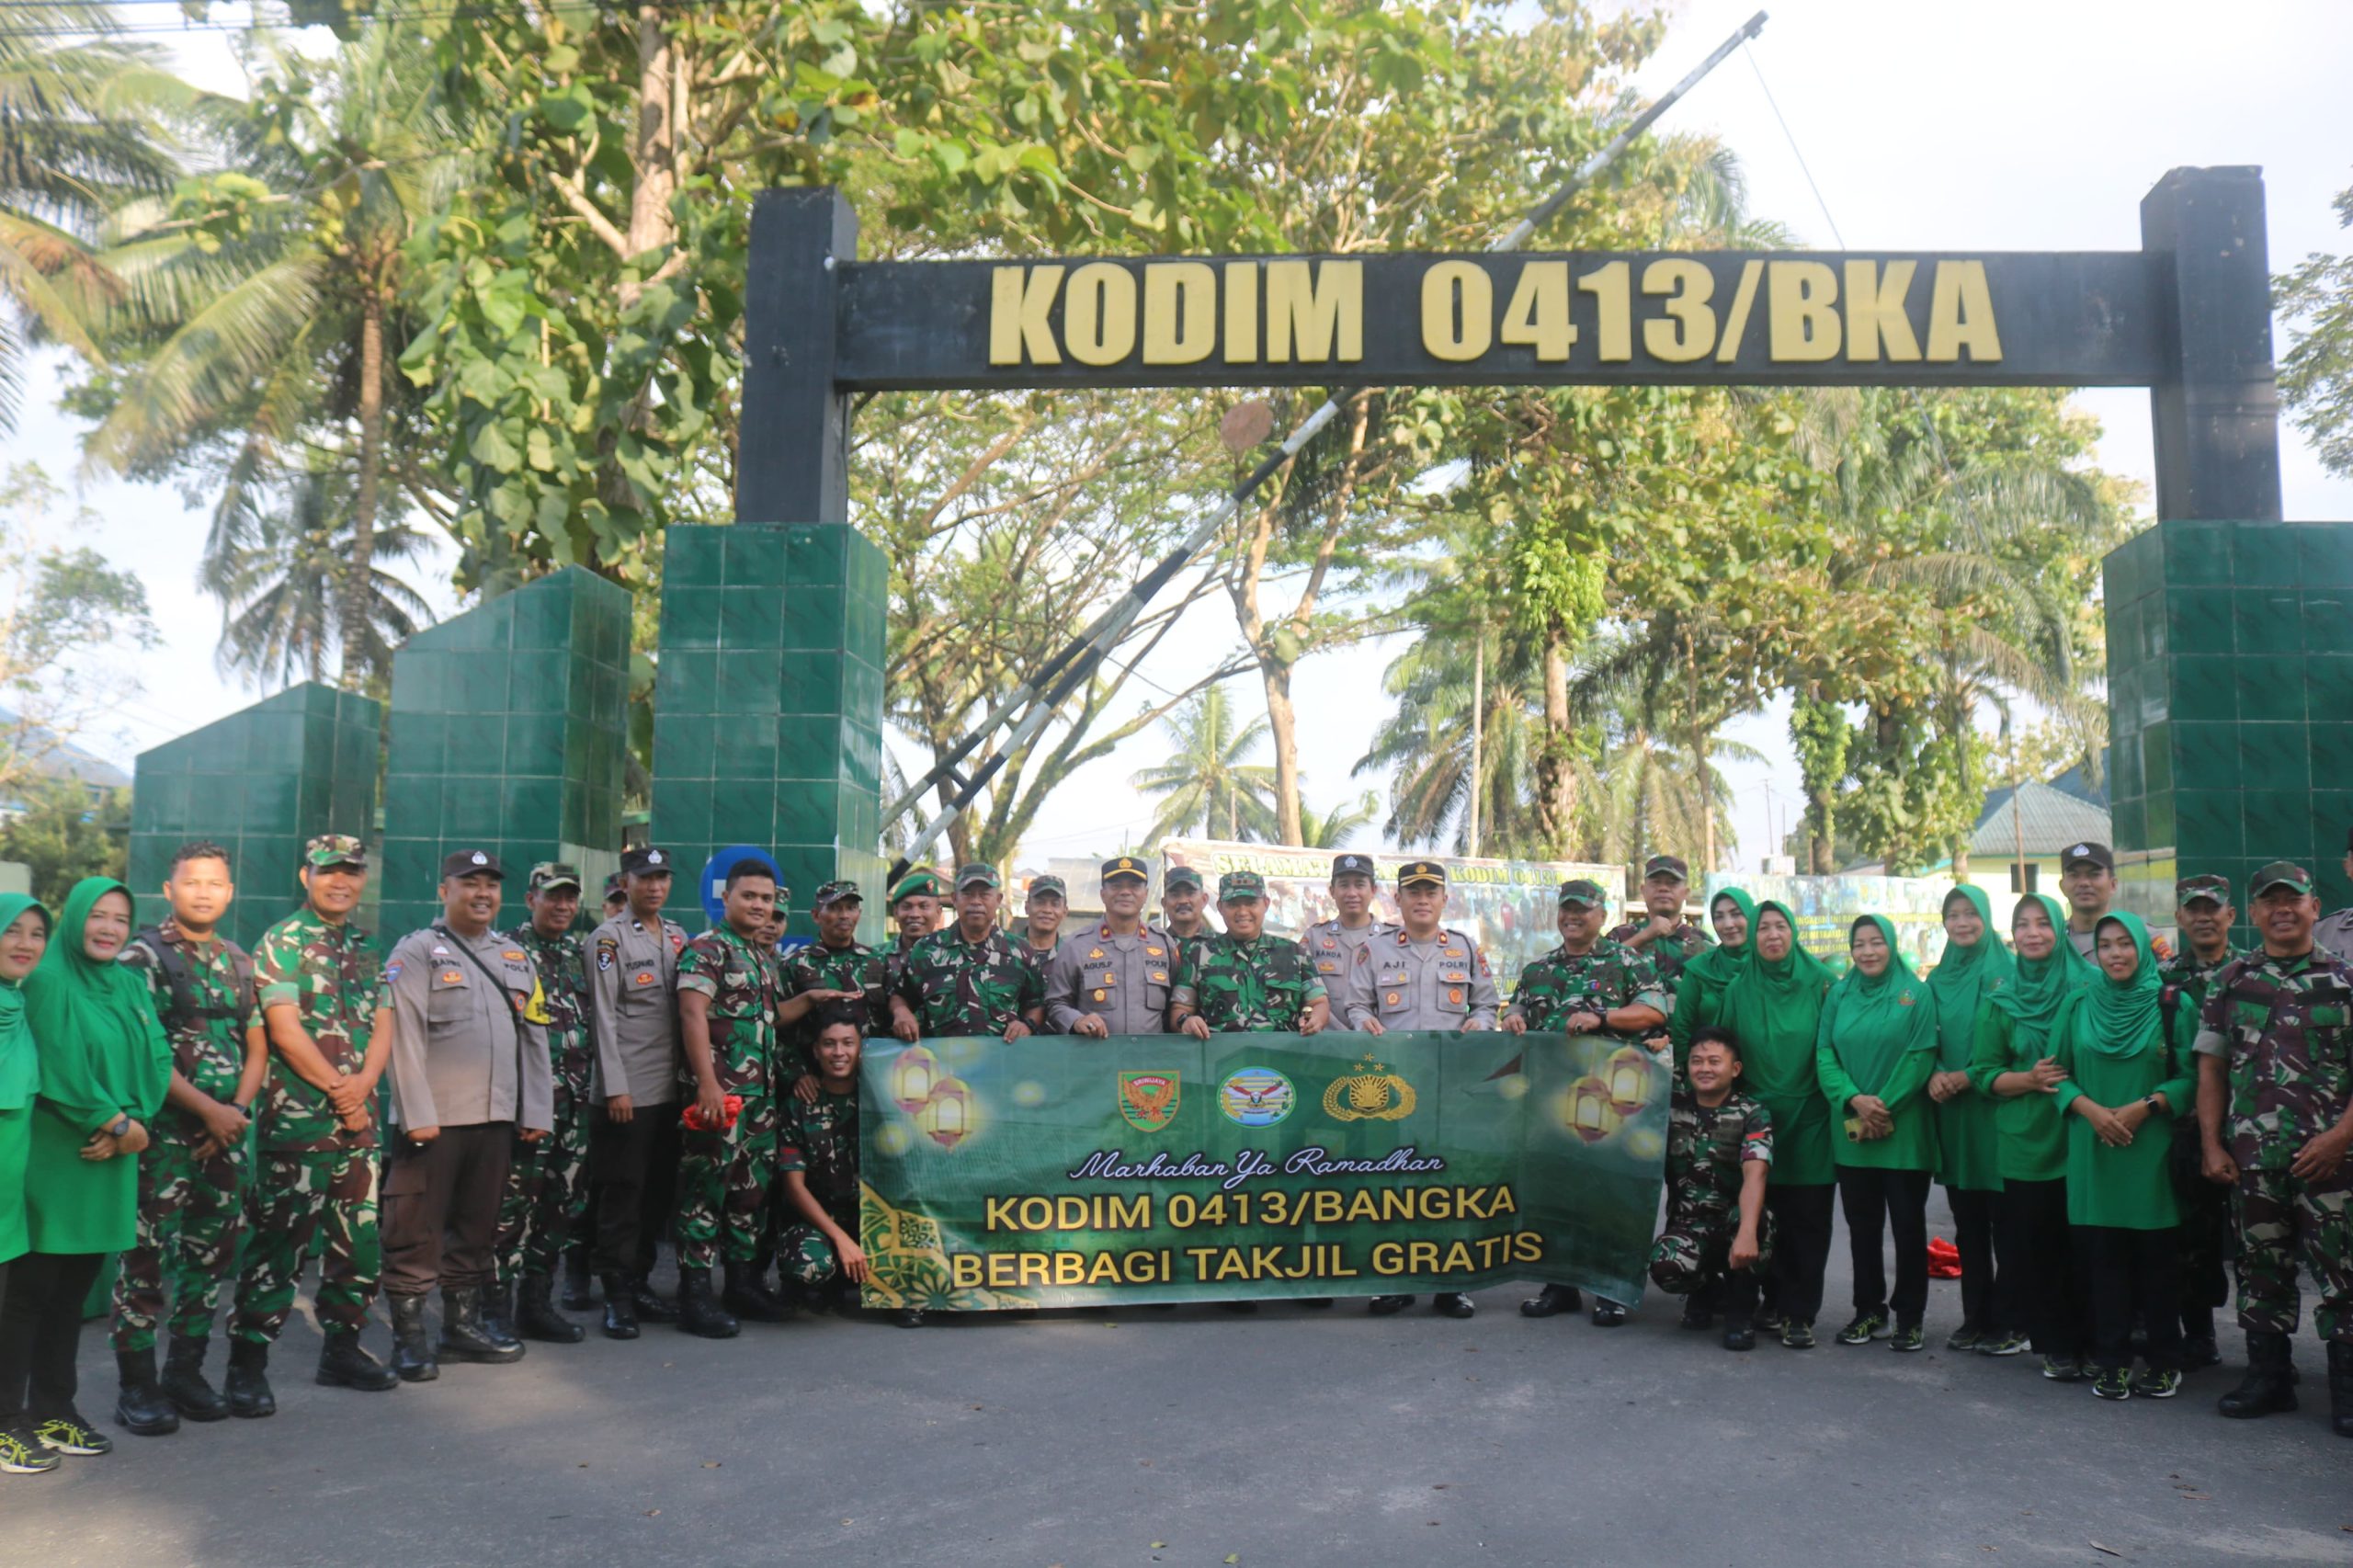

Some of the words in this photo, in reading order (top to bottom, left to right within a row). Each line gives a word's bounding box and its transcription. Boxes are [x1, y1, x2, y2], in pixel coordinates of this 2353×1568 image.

[987, 260, 1363, 366] KODIM
[1421, 258, 2004, 362] 0413/BKA
[1213, 854, 1331, 878] SELAMAT
[1449, 866, 1510, 885] KODIM
[1382, 961, 1406, 970] AJI
[1438, 960, 1469, 970] POLRI
[1069, 1150, 1230, 1179] Marhaban
[1224, 1150, 1278, 1190] Ya
[1284, 1147, 1445, 1176] Ramadhan
[986, 1196, 1151, 1231] KODIM
[1168, 1186, 1516, 1227] 0413/BANGKA
[952, 1250, 1170, 1288] BERBAGI
[1187, 1244, 1358, 1280] TAKJIL
[1371, 1232, 1544, 1275] GRATIS
